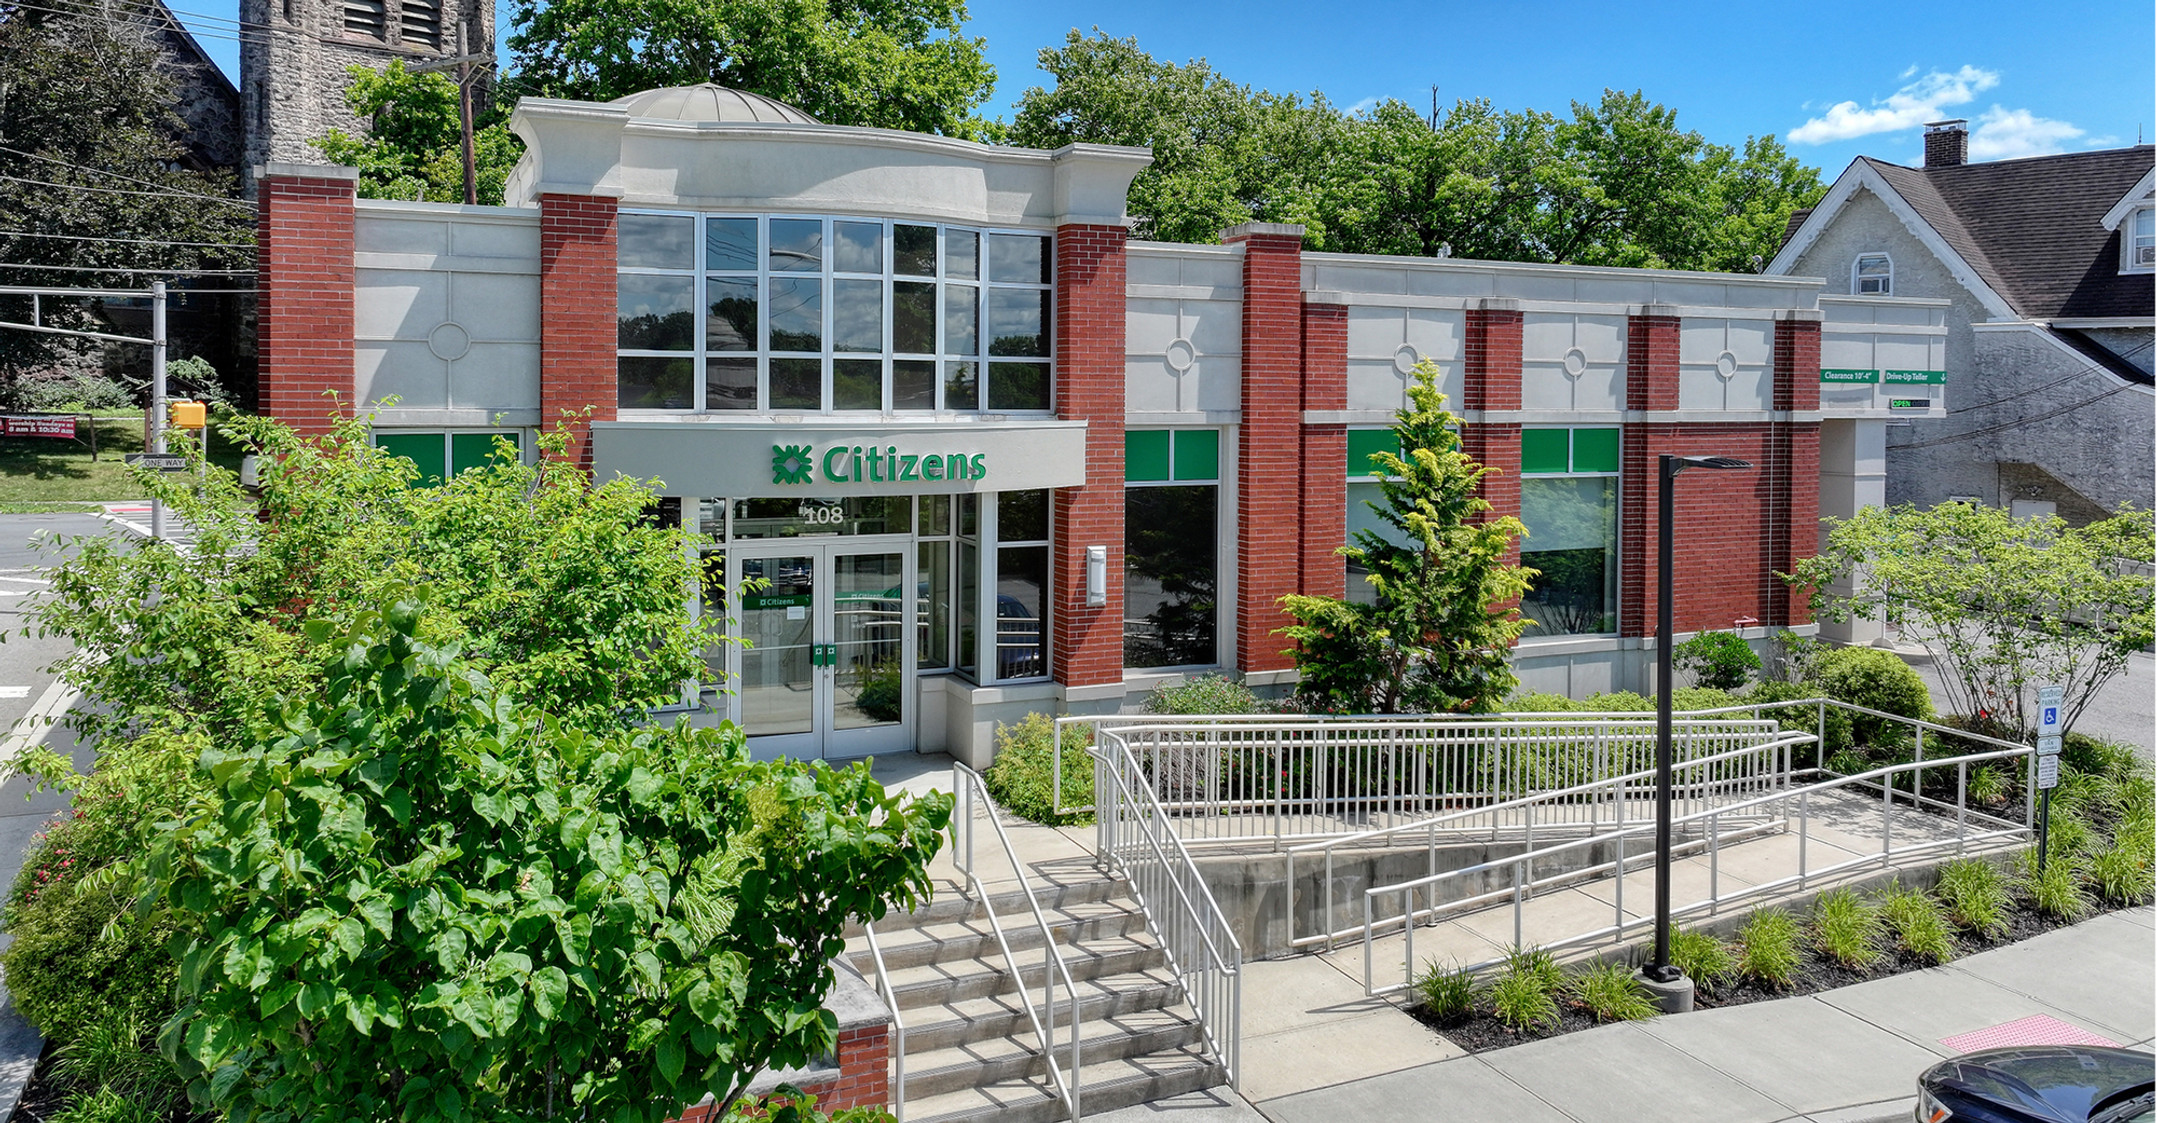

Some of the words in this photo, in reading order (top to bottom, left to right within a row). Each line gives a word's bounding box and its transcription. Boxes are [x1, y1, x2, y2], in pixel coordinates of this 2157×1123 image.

[1825, 371, 1854, 379] Clearance
[1886, 373, 1912, 381] Drive-Up
[1912, 373, 1928, 381] Teller
[8, 421, 36, 429] worship
[144, 459, 162, 467] ONE
[822, 445, 987, 483] Citizens
[804, 506, 844, 524] 108
[767, 598, 795, 606] Citizens
